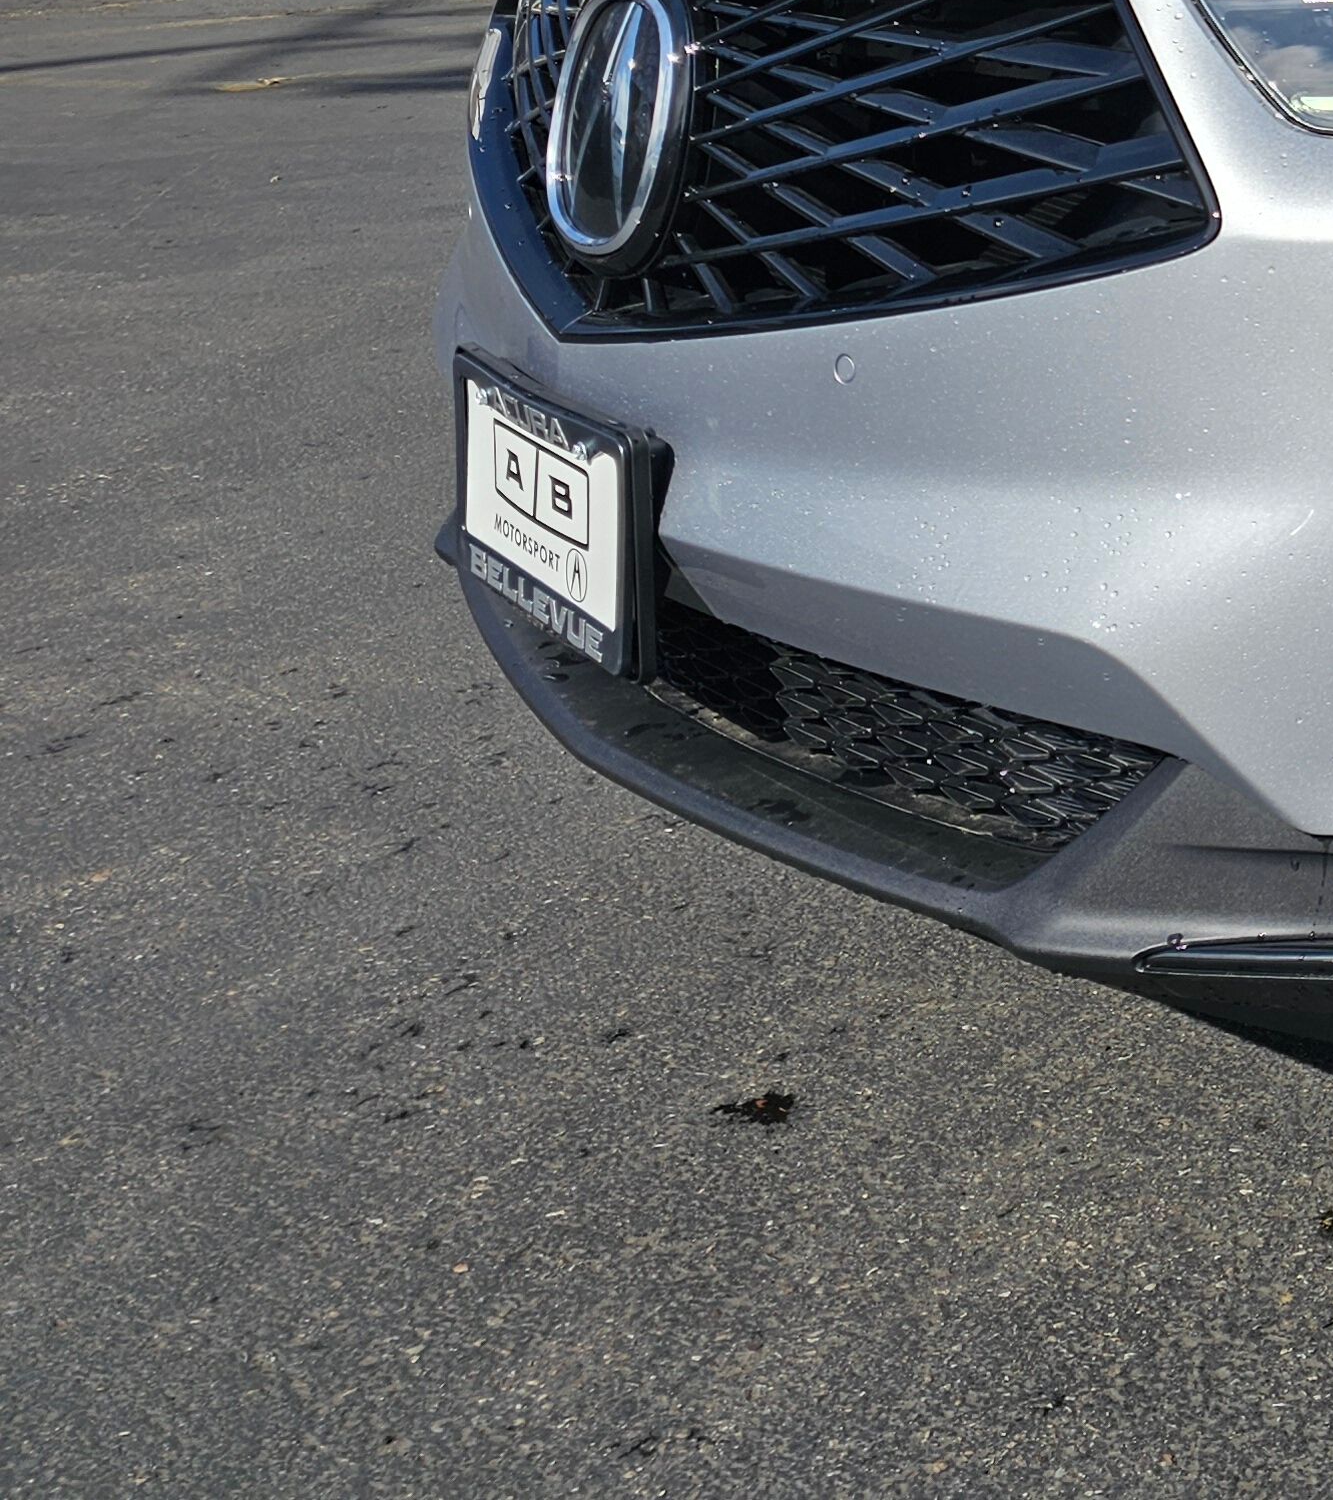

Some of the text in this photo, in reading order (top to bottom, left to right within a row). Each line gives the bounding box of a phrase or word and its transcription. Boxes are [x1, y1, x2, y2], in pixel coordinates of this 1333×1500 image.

[492, 386, 570, 451] ACURA
[505, 448, 573, 520] A B
[493, 512, 562, 573] MOTORSPORT
[468, 542, 604, 663] BELLEVUE
